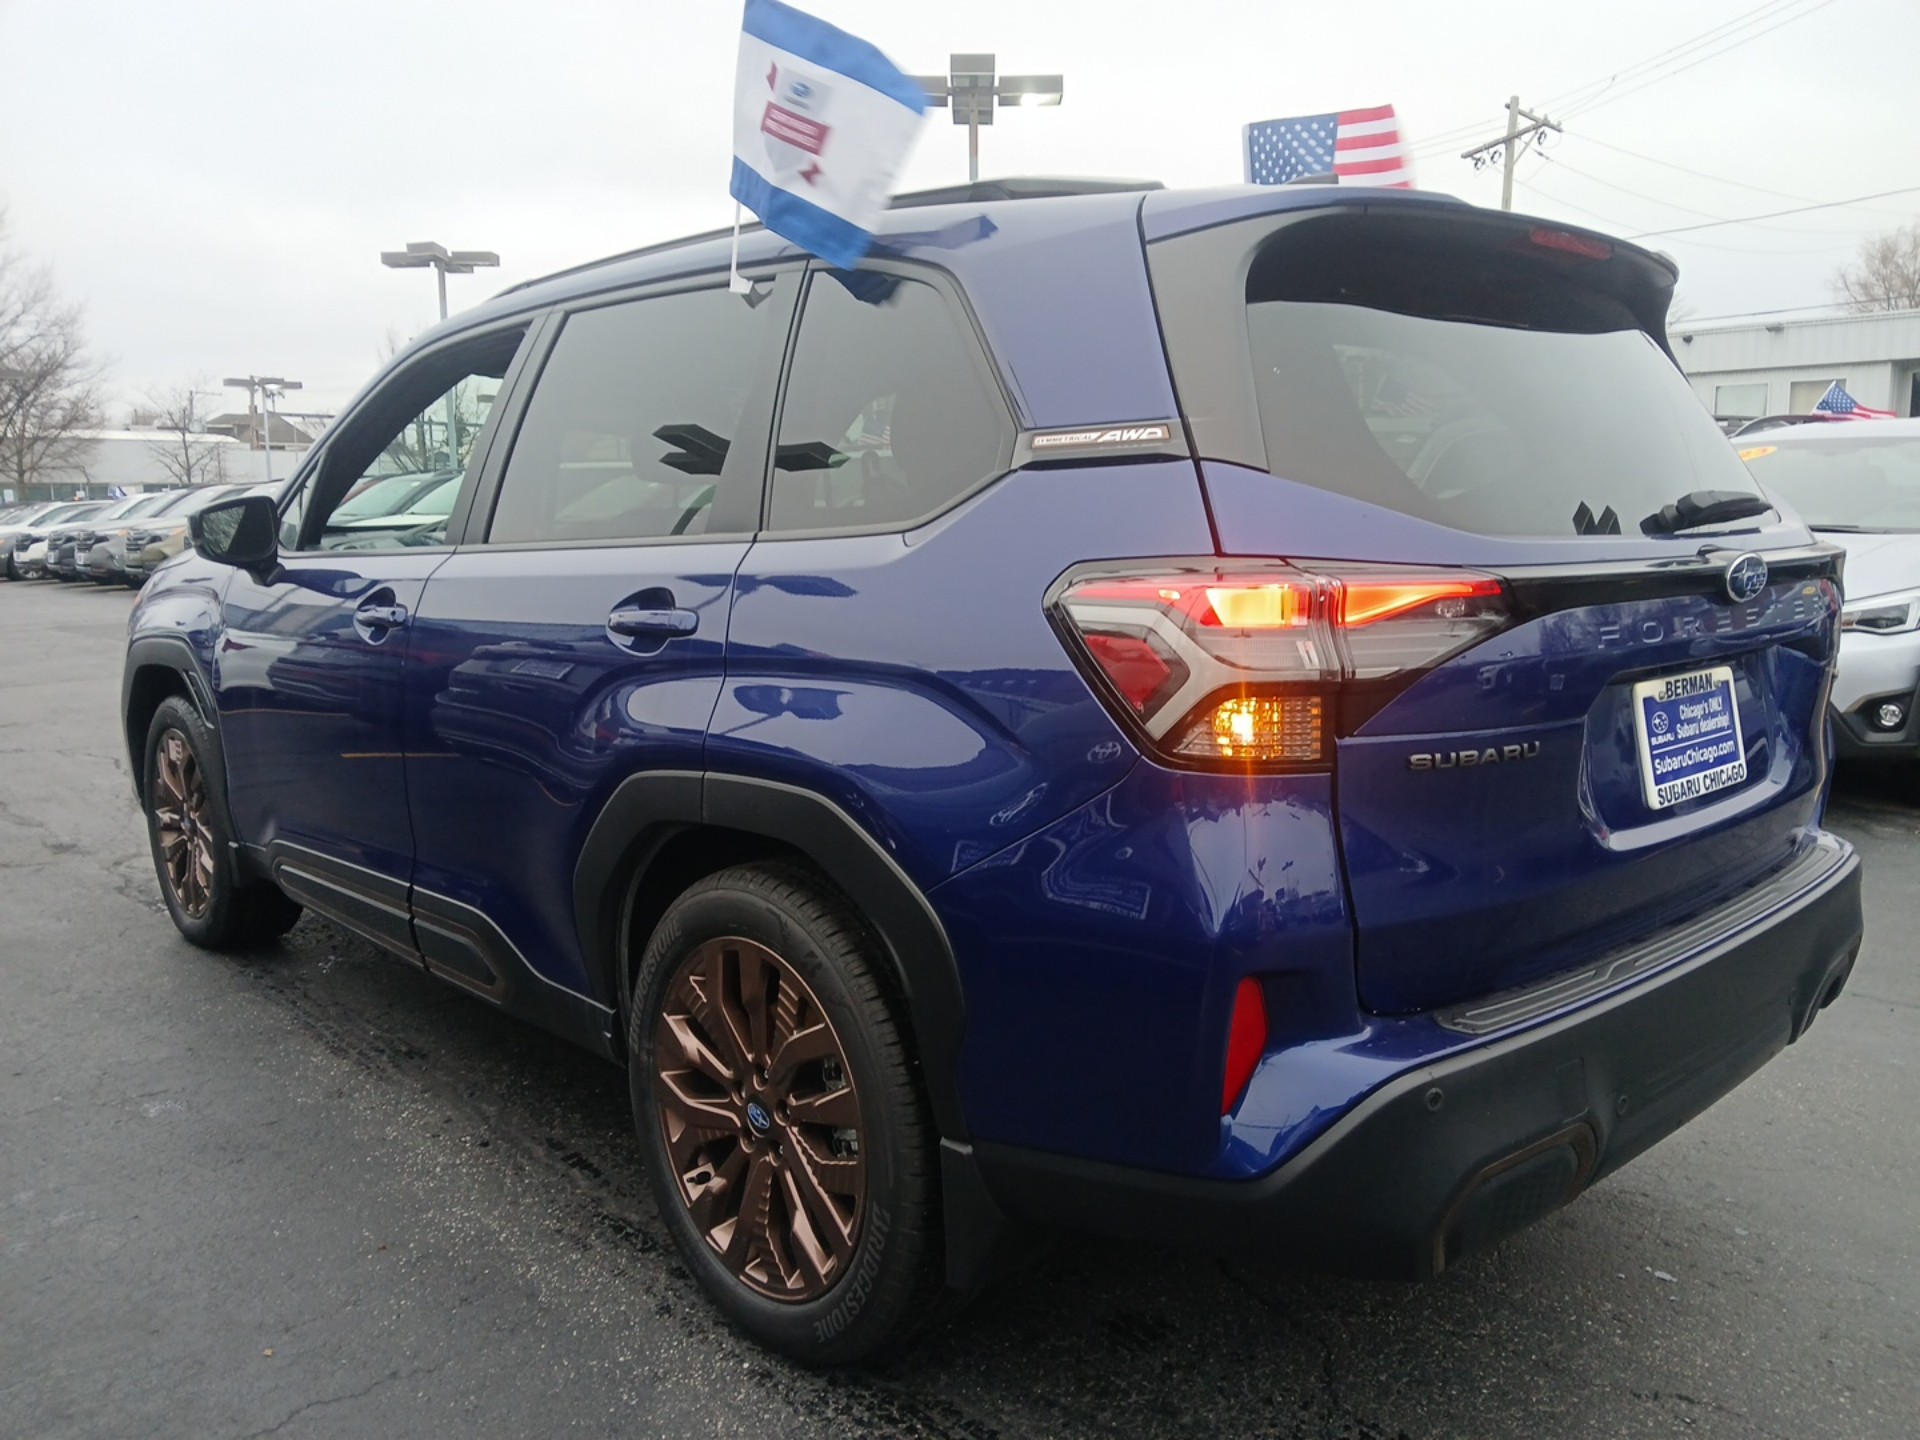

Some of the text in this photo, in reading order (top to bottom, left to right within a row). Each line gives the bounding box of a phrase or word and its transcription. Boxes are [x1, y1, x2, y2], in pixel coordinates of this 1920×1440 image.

[1096, 427, 1163, 443] AWD
[1665, 672, 1713, 699] BERMAN
[1679, 695, 1723, 720] Chicago's ONLY
[1651, 732, 1675, 746] SUBARU
[1676, 711, 1730, 739] Subaru dealership!
[1408, 740, 1541, 770] SUBARU
[1654, 740, 1736, 775] SubaruChicago.com
[1657, 763, 1745, 806] SUBARU CHICAGO
[812, 1199, 891, 1344] BRIDGESTONE
